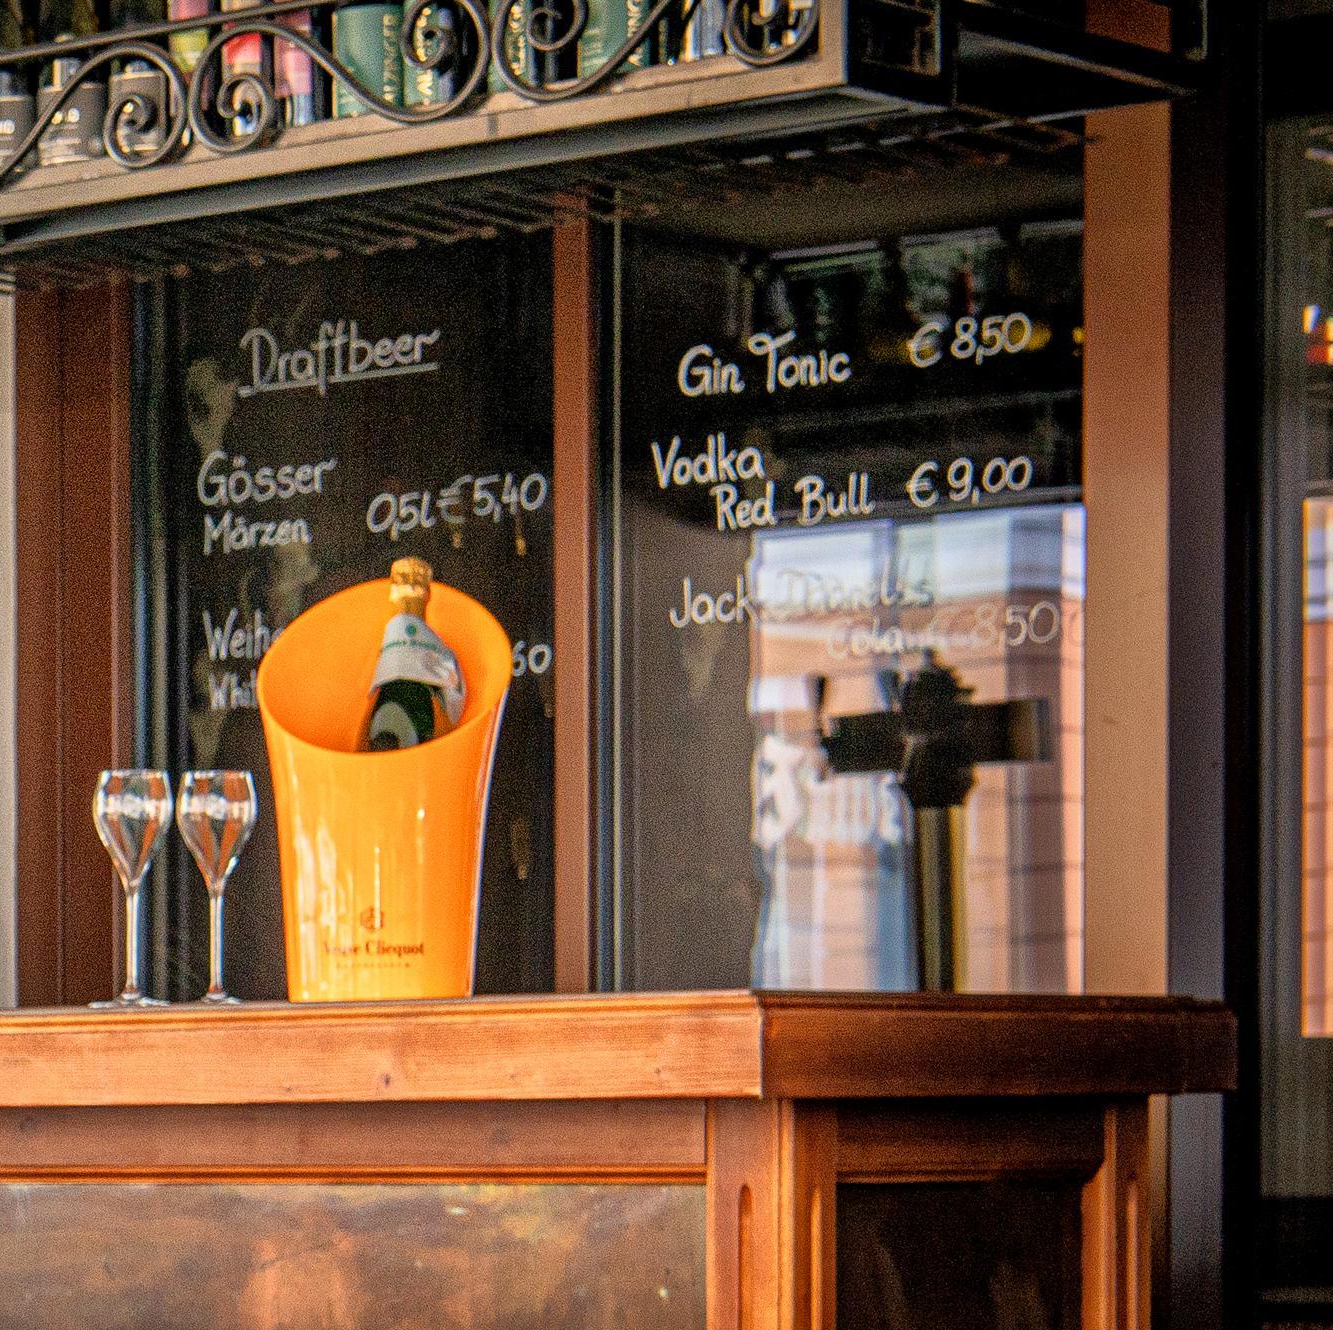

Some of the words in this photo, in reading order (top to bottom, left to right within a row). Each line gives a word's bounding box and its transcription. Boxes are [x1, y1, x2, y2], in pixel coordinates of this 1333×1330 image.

[239, 320, 442, 396] Draftbeer
[677, 343, 746, 397] Gin
[747, 329, 852, 394] Tonic
[197, 451, 338, 507] Gösser
[651, 432, 766, 489] Vodka
[709, 482, 778, 531] Red
[794, 471, 877, 526] Bull
[669, 574, 759, 629] Jack
